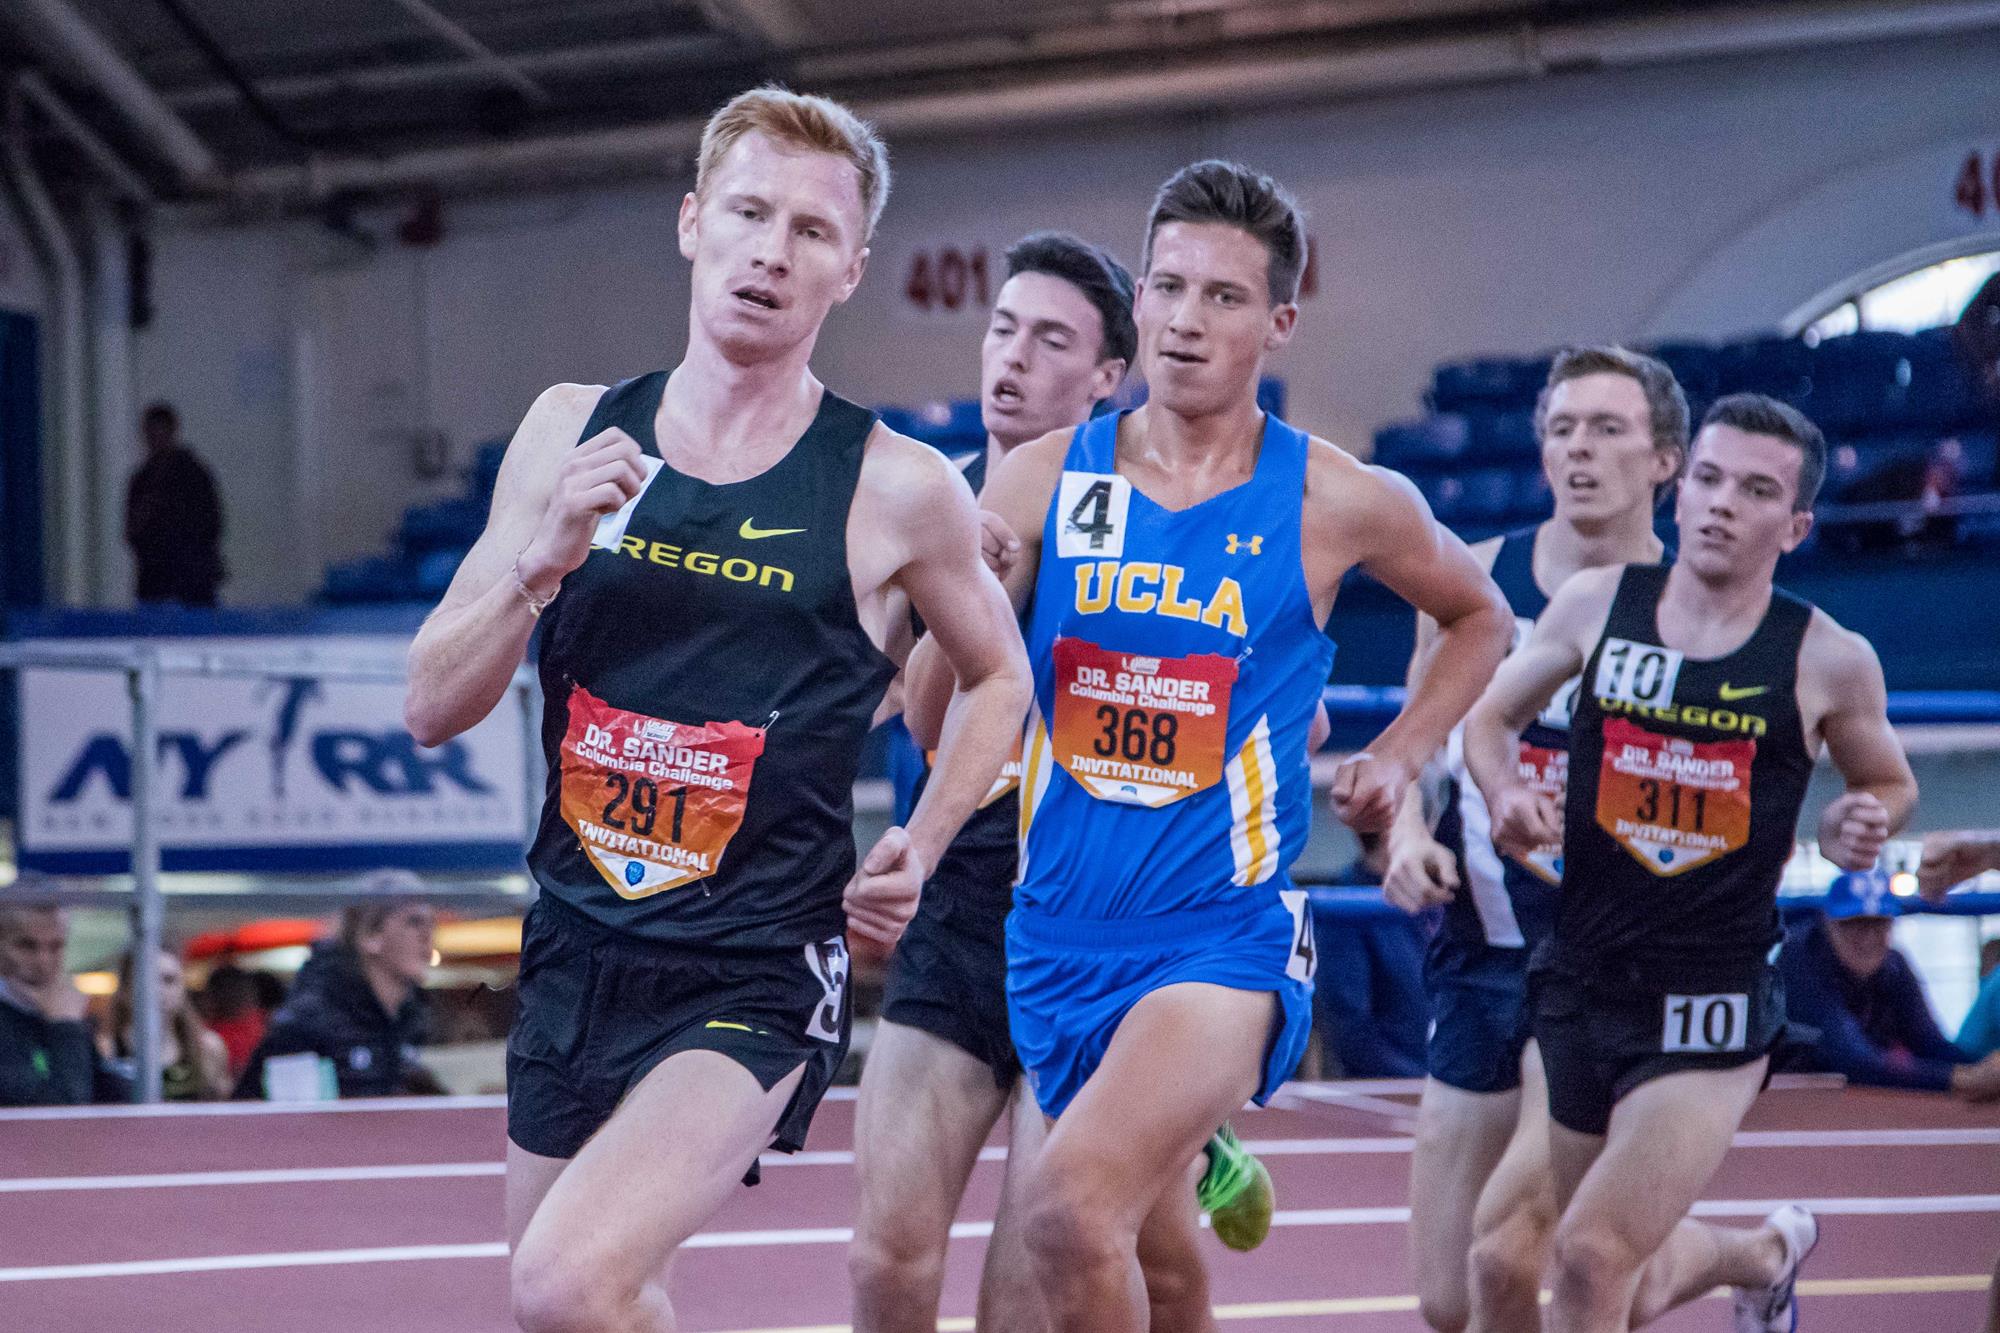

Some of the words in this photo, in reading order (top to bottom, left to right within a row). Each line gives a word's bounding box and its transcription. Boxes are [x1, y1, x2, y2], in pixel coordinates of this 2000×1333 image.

[1065, 479, 1114, 550] 4
[590, 534, 795, 593] REGON
[1075, 561, 1248, 638] UCLA
[1077, 665, 1110, 690] DR.
[1115, 672, 1210, 701] SANDER
[1610, 642, 1668, 701] 10
[1069, 682, 1135, 706] Columbia
[1138, 694, 1216, 717] Challenge
[584, 723, 616, 755] DR.
[623, 736, 729, 774] SANDER
[1093, 704, 1179, 766] 368
[575, 741, 645, 772] Columbia
[648, 761, 733, 791] Challenge
[1071, 754, 1199, 788] INVITATIONAL
[602, 772, 688, 844] 291
[1636, 778, 1706, 832] 311
[578, 818, 710, 872] INVITATIONAL
[1296, 897, 1314, 977] 4
[1673, 999, 1734, 1050] 10
